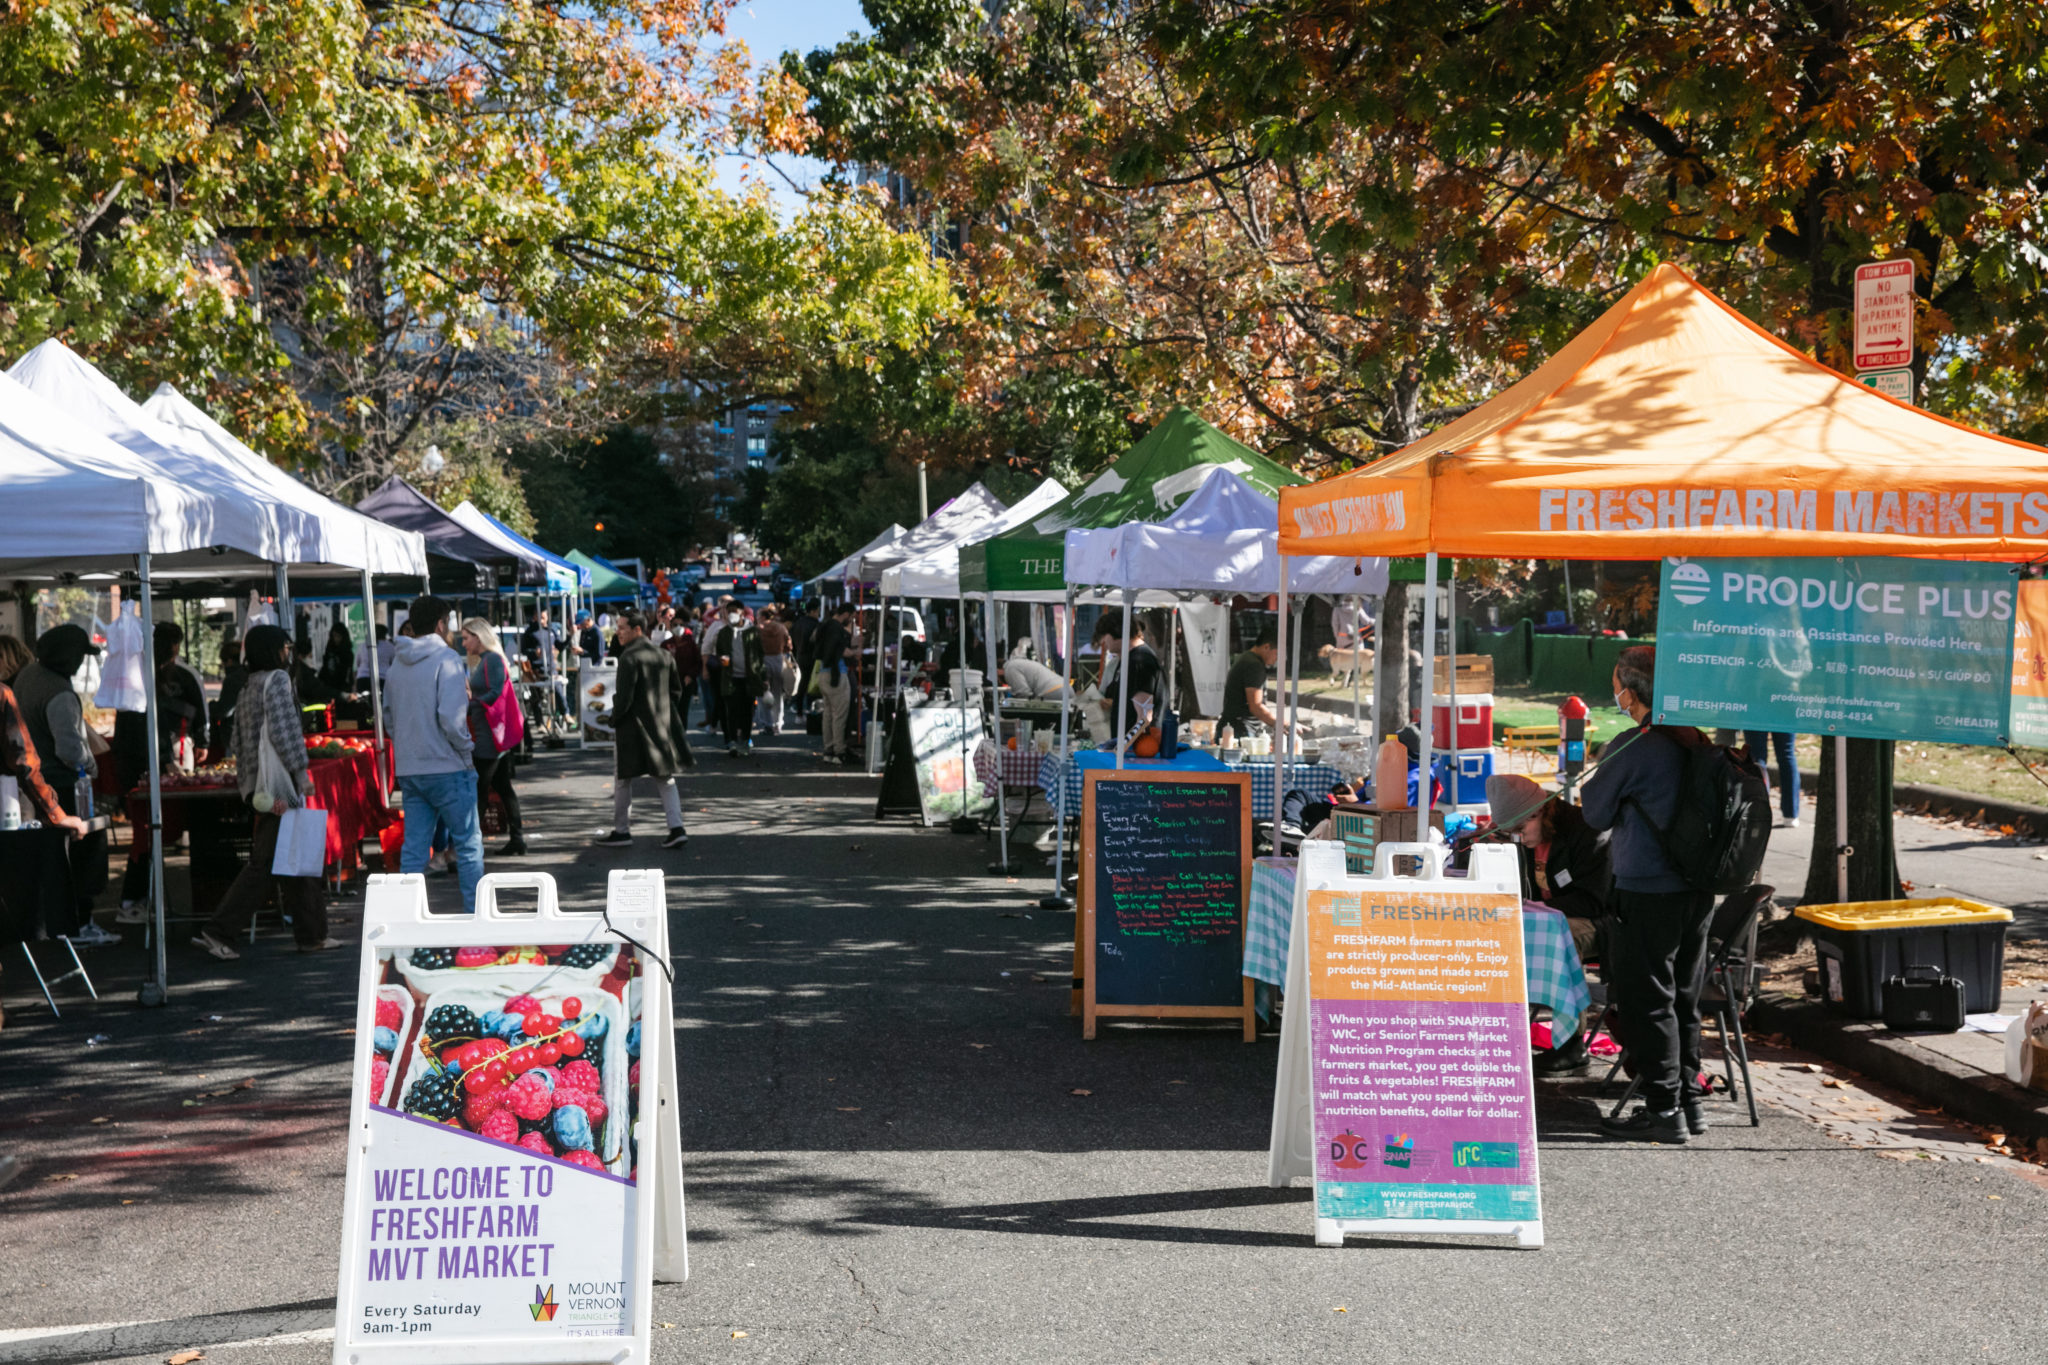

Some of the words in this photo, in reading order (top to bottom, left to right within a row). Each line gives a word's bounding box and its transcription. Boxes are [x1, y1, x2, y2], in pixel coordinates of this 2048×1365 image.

[1864, 267, 1881, 278] TOW
[1877, 281, 1891, 292] NO
[1864, 294, 1904, 308] STANDING
[1870, 307, 1906, 321] PARKING
[1867, 322, 1902, 336] ANYTIME
[1539, 488, 1818, 532] FRESHFARM
[1833, 490, 2048, 535] MARKETS
[1020, 558, 1061, 574] THE
[1723, 572, 1904, 614] PRODUCE
[1919, 586, 2012, 620] PLUS
[1692, 619, 1775, 637] Information
[1779, 627, 1805, 639] and
[1808, 627, 1880, 644] Assistance
[1884, 632, 1946, 649] Provided
[1950, 638, 1982, 651] Here
[1678, 653, 1745, 667] ASISTENCIA
[1683, 699, 1748, 712] FRESHFARM
[1795, 706, 1822, 720] (202)
[1935, 715, 1951, 726] DC
[1955, 716, 1999, 728] HEALTH
[1371, 905, 1499, 921] FRESHFARM
[1334, 934, 1406, 946] FRESHFARM
[1409, 936, 1452, 947] farmers
[1455, 938, 1500, 949] markets
[1326, 952, 1344, 960] are
[1347, 950, 1387, 962] strictly
[1390, 951, 1473, 963] producer-only.
[1477, 953, 1508, 965] Enjoy
[1327, 965, 1377, 976] products
[1380, 967, 1415, 977] grown
[1418, 966, 1438, 976] and
[1441, 966, 1471, 977] made
[1474, 969, 1509, 978] across
[1351, 980, 1369, 990] the
[1373, 980, 1443, 991] Mid-Atlantic
[1446, 981, 1486, 994] region!
[1329, 1014, 1363, 1024] When
[1366, 1016, 1388, 1026] you
[1390, 1016, 1417, 1027] shop
[1420, 1016, 1445, 1026] with
[1447, 1016, 1510, 1028] SNAP/EBT,
[1332, 1029, 1361, 1041] WIC,
[1363, 1032, 1377, 1040] or
[1379, 1029, 1416, 1040] Senior
[1419, 1031, 1465, 1041] Farmers
[1467, 1031, 1508, 1042] Market
[1329, 1044, 1383, 1055] Nutrition
[1386, 1045, 1435, 1058] Program
[1438, 1046, 1476, 1057] checks
[1479, 1048, 1490, 1057] at
[1492, 1047, 1511, 1057] the
[1321, 1059, 1365, 1070] farmers
[1368, 1060, 1413, 1072] market,
[1415, 1062, 1437, 1072] you
[1439, 1063, 1459, 1074] get
[1461, 1061, 1499, 1072] double
[1502, 1062, 1521, 1073] the
[1328, 1074, 1359, 1085] fruits
[1362, 1075, 1372, 1085] &
[1374, 1075, 1439, 1088] vegetables!
[1442, 1077, 1515, 1088] FRESHFARM
[1320, 1089, 1340, 1100] will
[1343, 1090, 1377, 1101] match
[1379, 1091, 1408, 1101] what
[1411, 1093, 1432, 1103] you
[1435, 1092, 1468, 1104] spend
[1471, 1092, 1496, 1103] with
[1499, 1094, 1525, 1105] your
[1326, 1105, 1377, 1116] nutrition
[1379, 1106, 1429, 1118] benefits,
[1432, 1107, 1464, 1117] dollar
[1467, 1107, 1484, 1118] for
[1487, 1108, 1522, 1119] dollar.
[374, 1166, 510, 1201] WELCOME
[520, 1165, 553, 1198] TO
[1381, 1190, 1477, 1200] WWW.FRESHFARM.ORG
[371, 1204, 539, 1241] FRESHFARM
[368, 1247, 428, 1281] MVT
[438, 1244, 554, 1280] MARKET
[568, 1281, 627, 1295] MOUNT
[364, 1305, 407, 1318] Every
[413, 1303, 481, 1317] Saturday
[568, 1297, 626, 1310] VERNON
[363, 1321, 432, 1335] 9am-1pm
[603, 1328, 625, 1336] HERE
